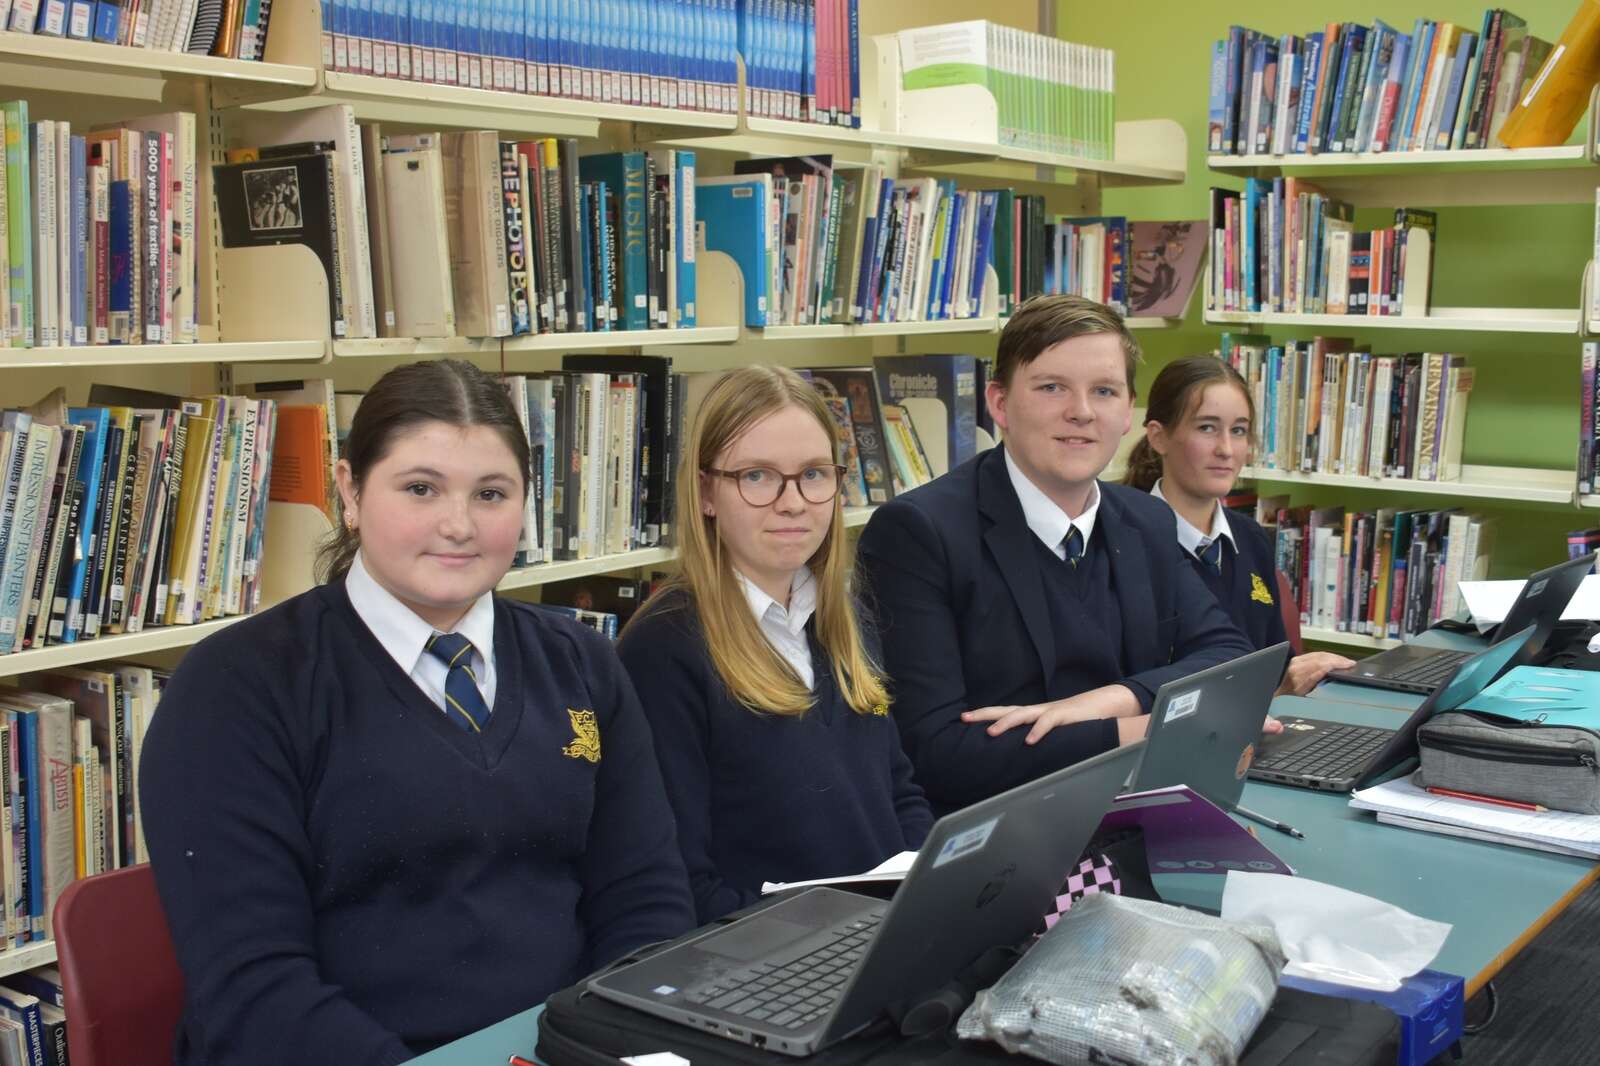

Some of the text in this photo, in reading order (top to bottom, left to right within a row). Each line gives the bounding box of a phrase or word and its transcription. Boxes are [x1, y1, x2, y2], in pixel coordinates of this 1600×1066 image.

[1300, 80, 1317, 134] Australia
[502, 144, 520, 191] THE
[146, 139, 158, 266] 5000 years of textiles
[182, 163, 193, 240] NEEDLEWORK
[492, 185, 500, 216] LOST
[624, 165, 643, 256] MUSIC
[97, 223, 105, 248] Jewelry
[495, 219, 504, 268] DIGGERS
[505, 191, 525, 270] PHOTO
[97, 249, 105, 274] Making
[1419, 353, 1443, 466] RENAISSANC
[10, 431, 28, 483] TECHNIQUES
[169, 425, 187, 497] William Blake
[213, 424, 223, 462] ALLEN
[237, 409, 256, 522] EXPRESSIONISM
[5, 497, 16, 513] THE
[8, 484, 18, 496] OF
[104, 480, 117, 522] SURREALISTS
[208, 466, 217, 510] JONES
[7, 439, 48, 606] IMPRESSIONIST PAINTERS
[68, 499, 80, 537] Pop Art
[115, 454, 136, 585] GREEK PAINTING
[203, 516, 212, 556] SHEER
[98, 529, 109, 570] SURREALISM
[114, 685, 122, 696] THE
[50, 758, 73, 810] ARTISTS
[91, 758, 101, 843] DUTCH PAINTING
[3, 808, 11, 832] GOYA
[17, 795, 28, 882] MODERN EUROPEAN ART
[28, 1011, 43, 1066] MASTERPIECES
[54, 1027, 66, 1061] Outlines
